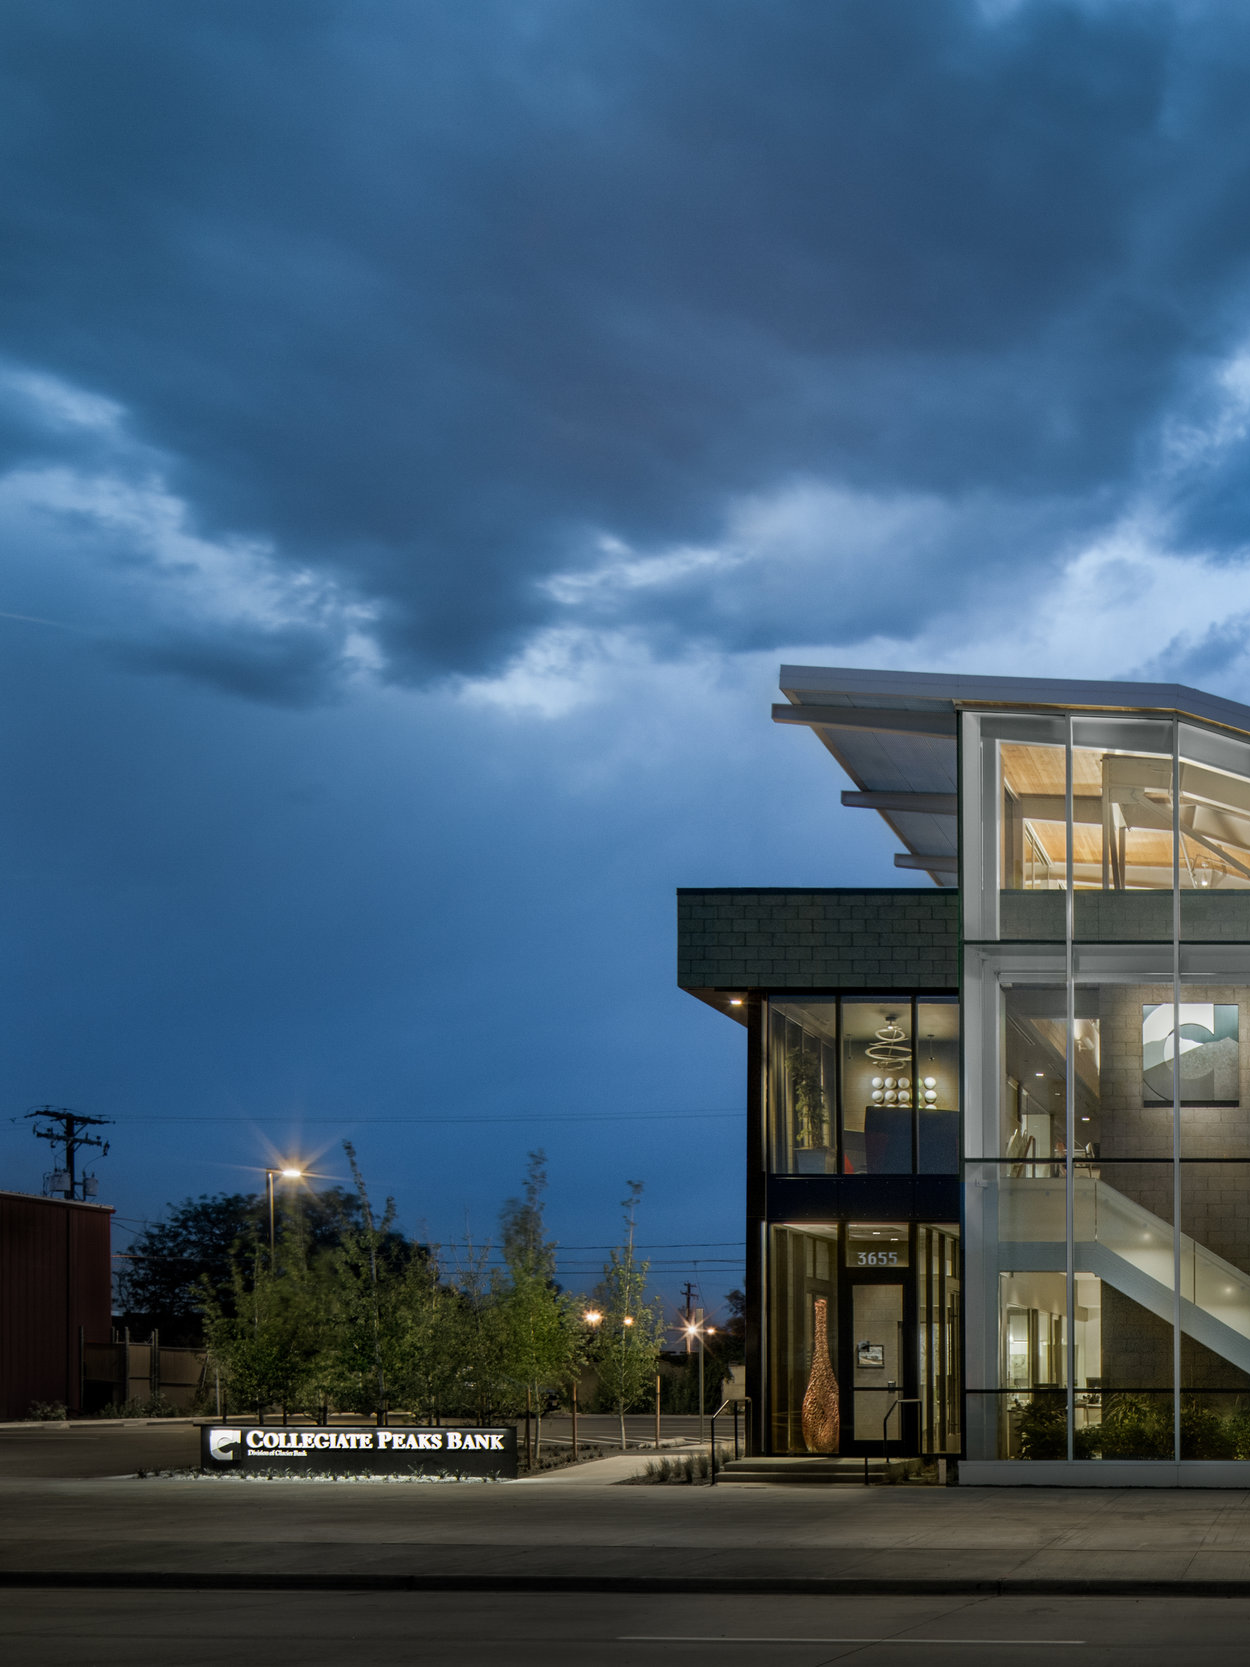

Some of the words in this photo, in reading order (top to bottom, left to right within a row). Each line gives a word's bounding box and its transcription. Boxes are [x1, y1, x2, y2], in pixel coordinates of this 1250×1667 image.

[857, 1252, 898, 1265] 3655
[246, 1430, 373, 1449] COLLEGIATE
[377, 1431, 442, 1450] PEAKS
[446, 1432, 504, 1450] BANK
